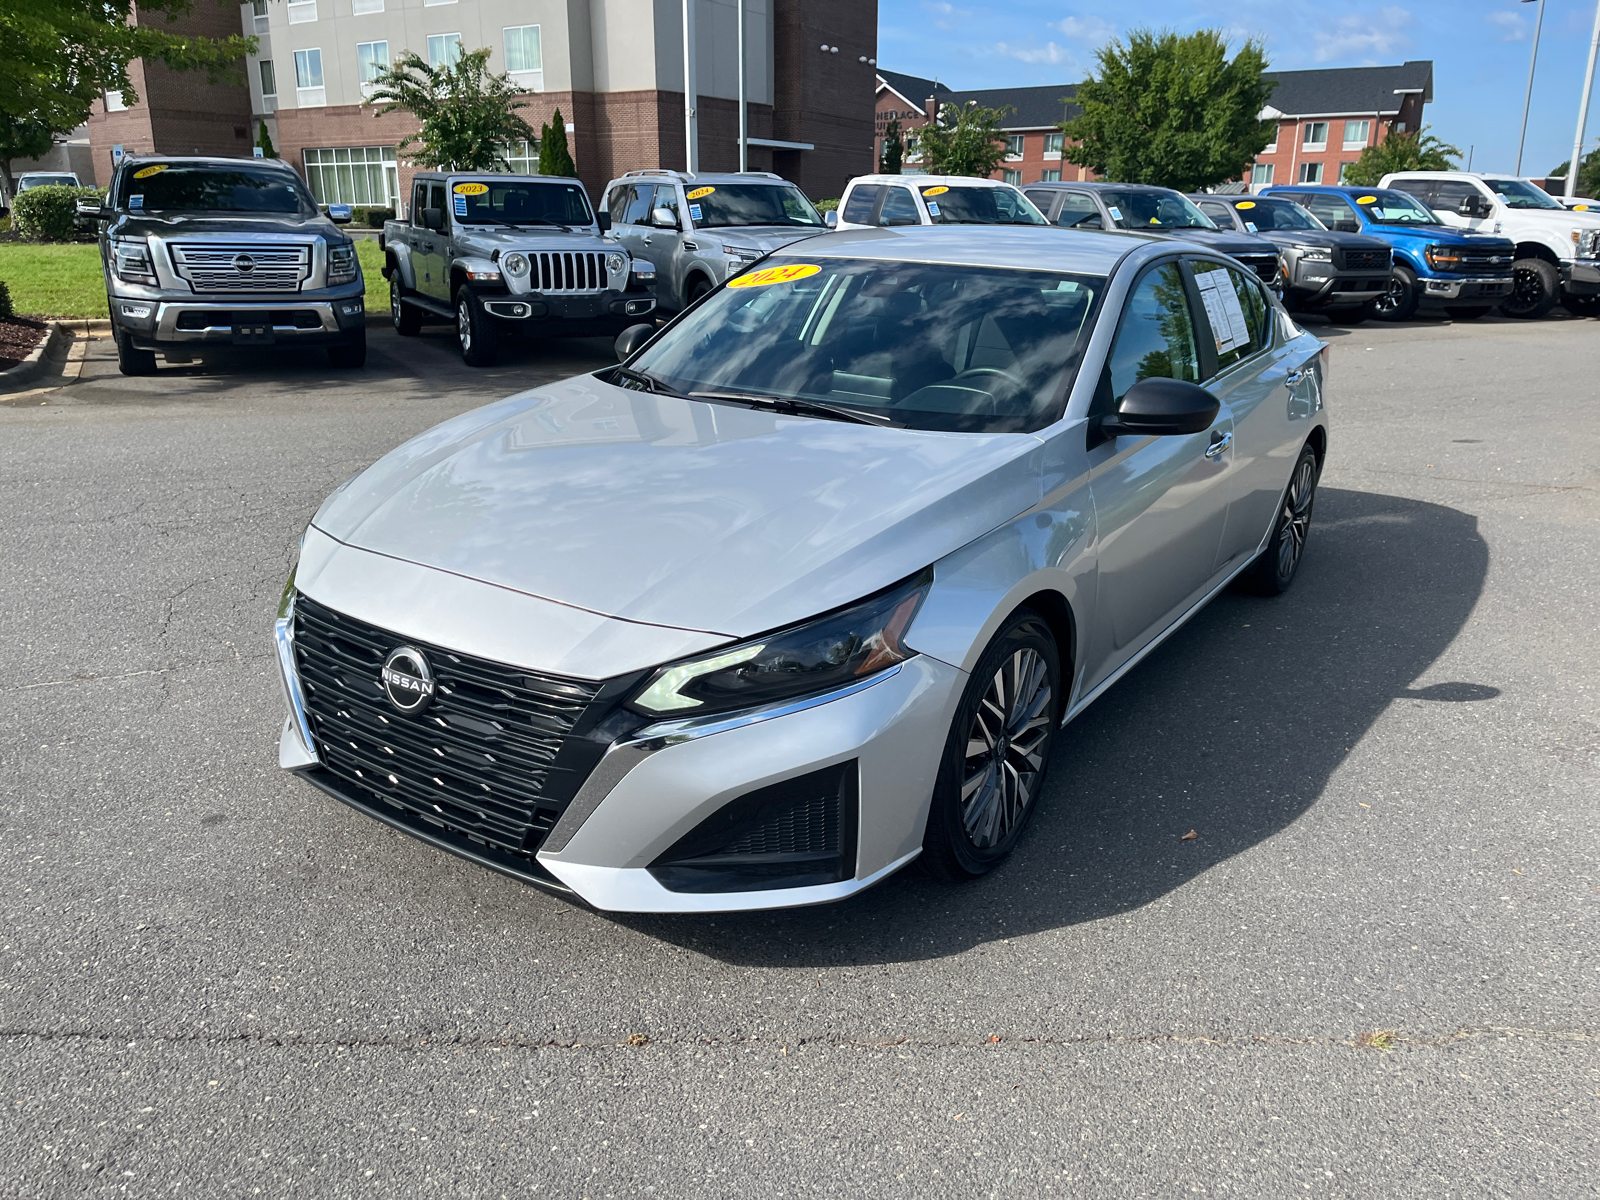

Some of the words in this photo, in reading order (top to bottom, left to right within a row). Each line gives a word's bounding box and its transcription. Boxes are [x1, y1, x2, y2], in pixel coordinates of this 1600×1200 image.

[691, 188, 709, 198] 2024
[735, 266, 807, 287] 2024
[382, 668, 432, 693] NISSAN
